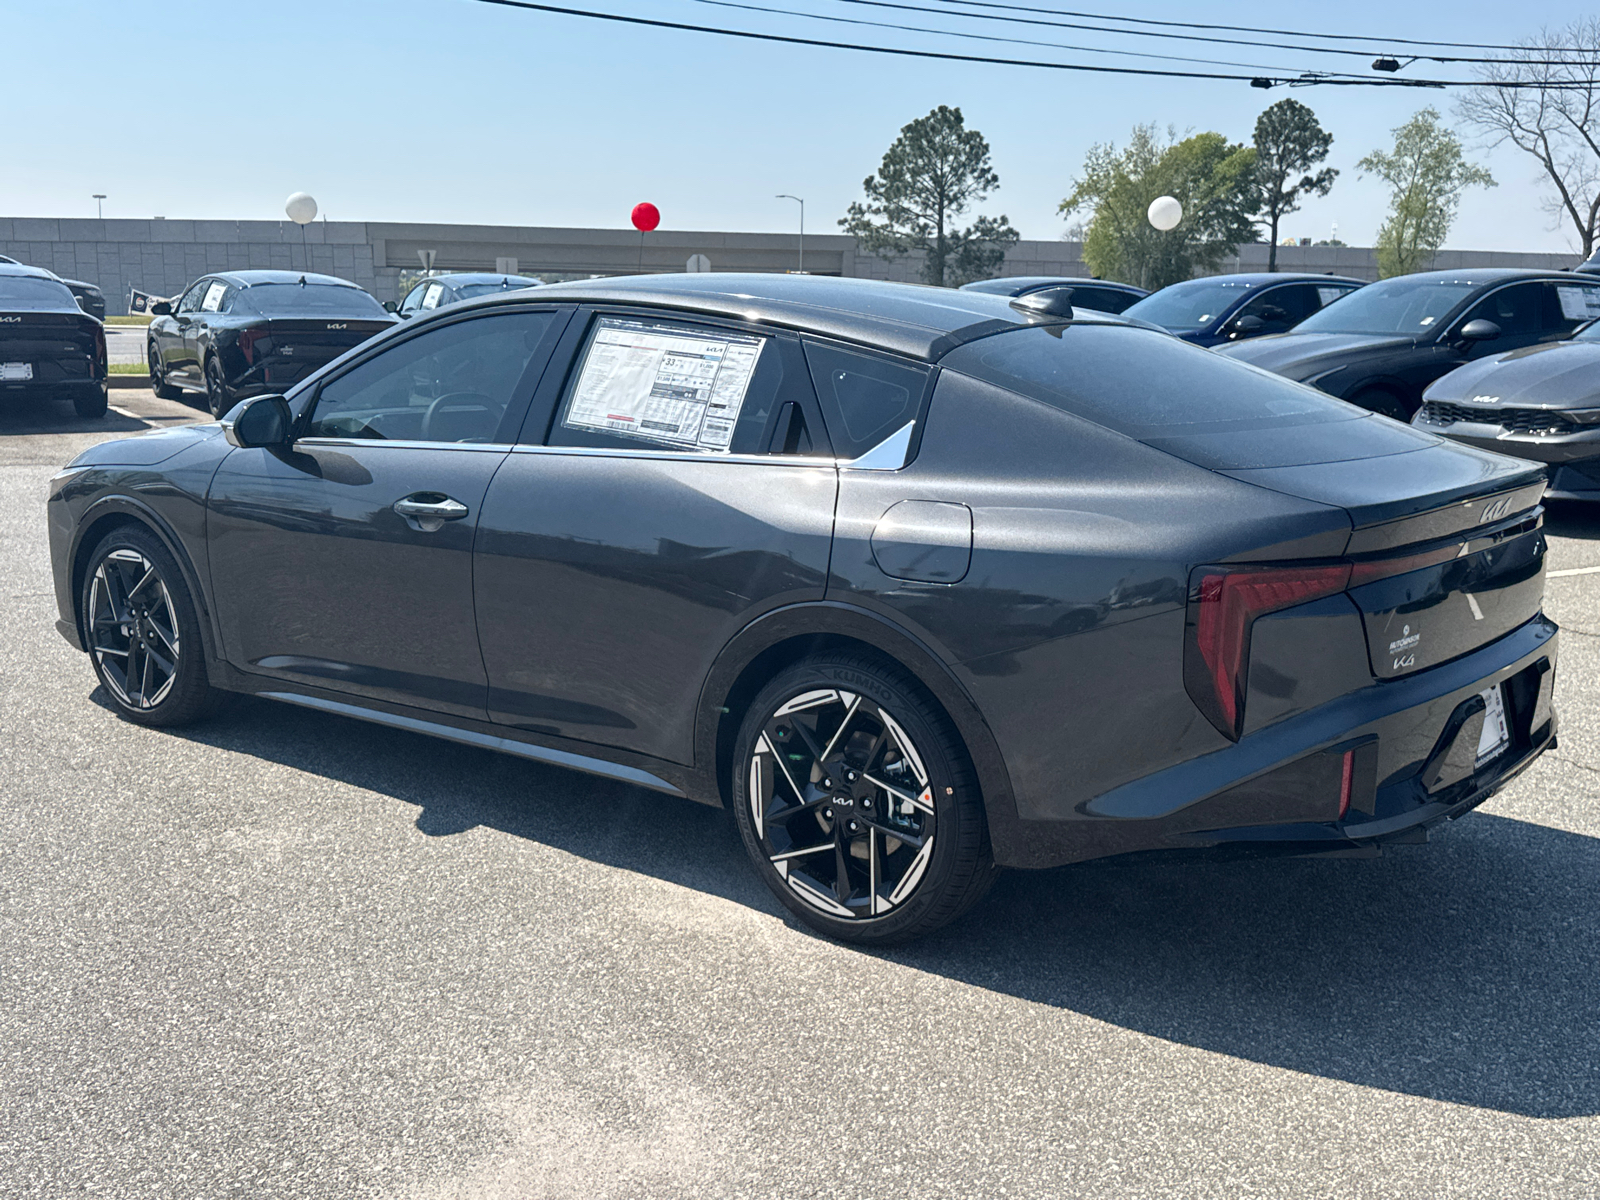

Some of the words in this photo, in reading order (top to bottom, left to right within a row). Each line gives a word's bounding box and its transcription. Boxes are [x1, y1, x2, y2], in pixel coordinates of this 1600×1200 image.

[665, 357, 676, 367] 33
[1472, 395, 1500, 404] KIA
[1479, 496, 1513, 523] KIA
[1393, 653, 1415, 670] K4
[833, 668, 893, 701] KUMHO
[832, 796, 854, 807] KIA
